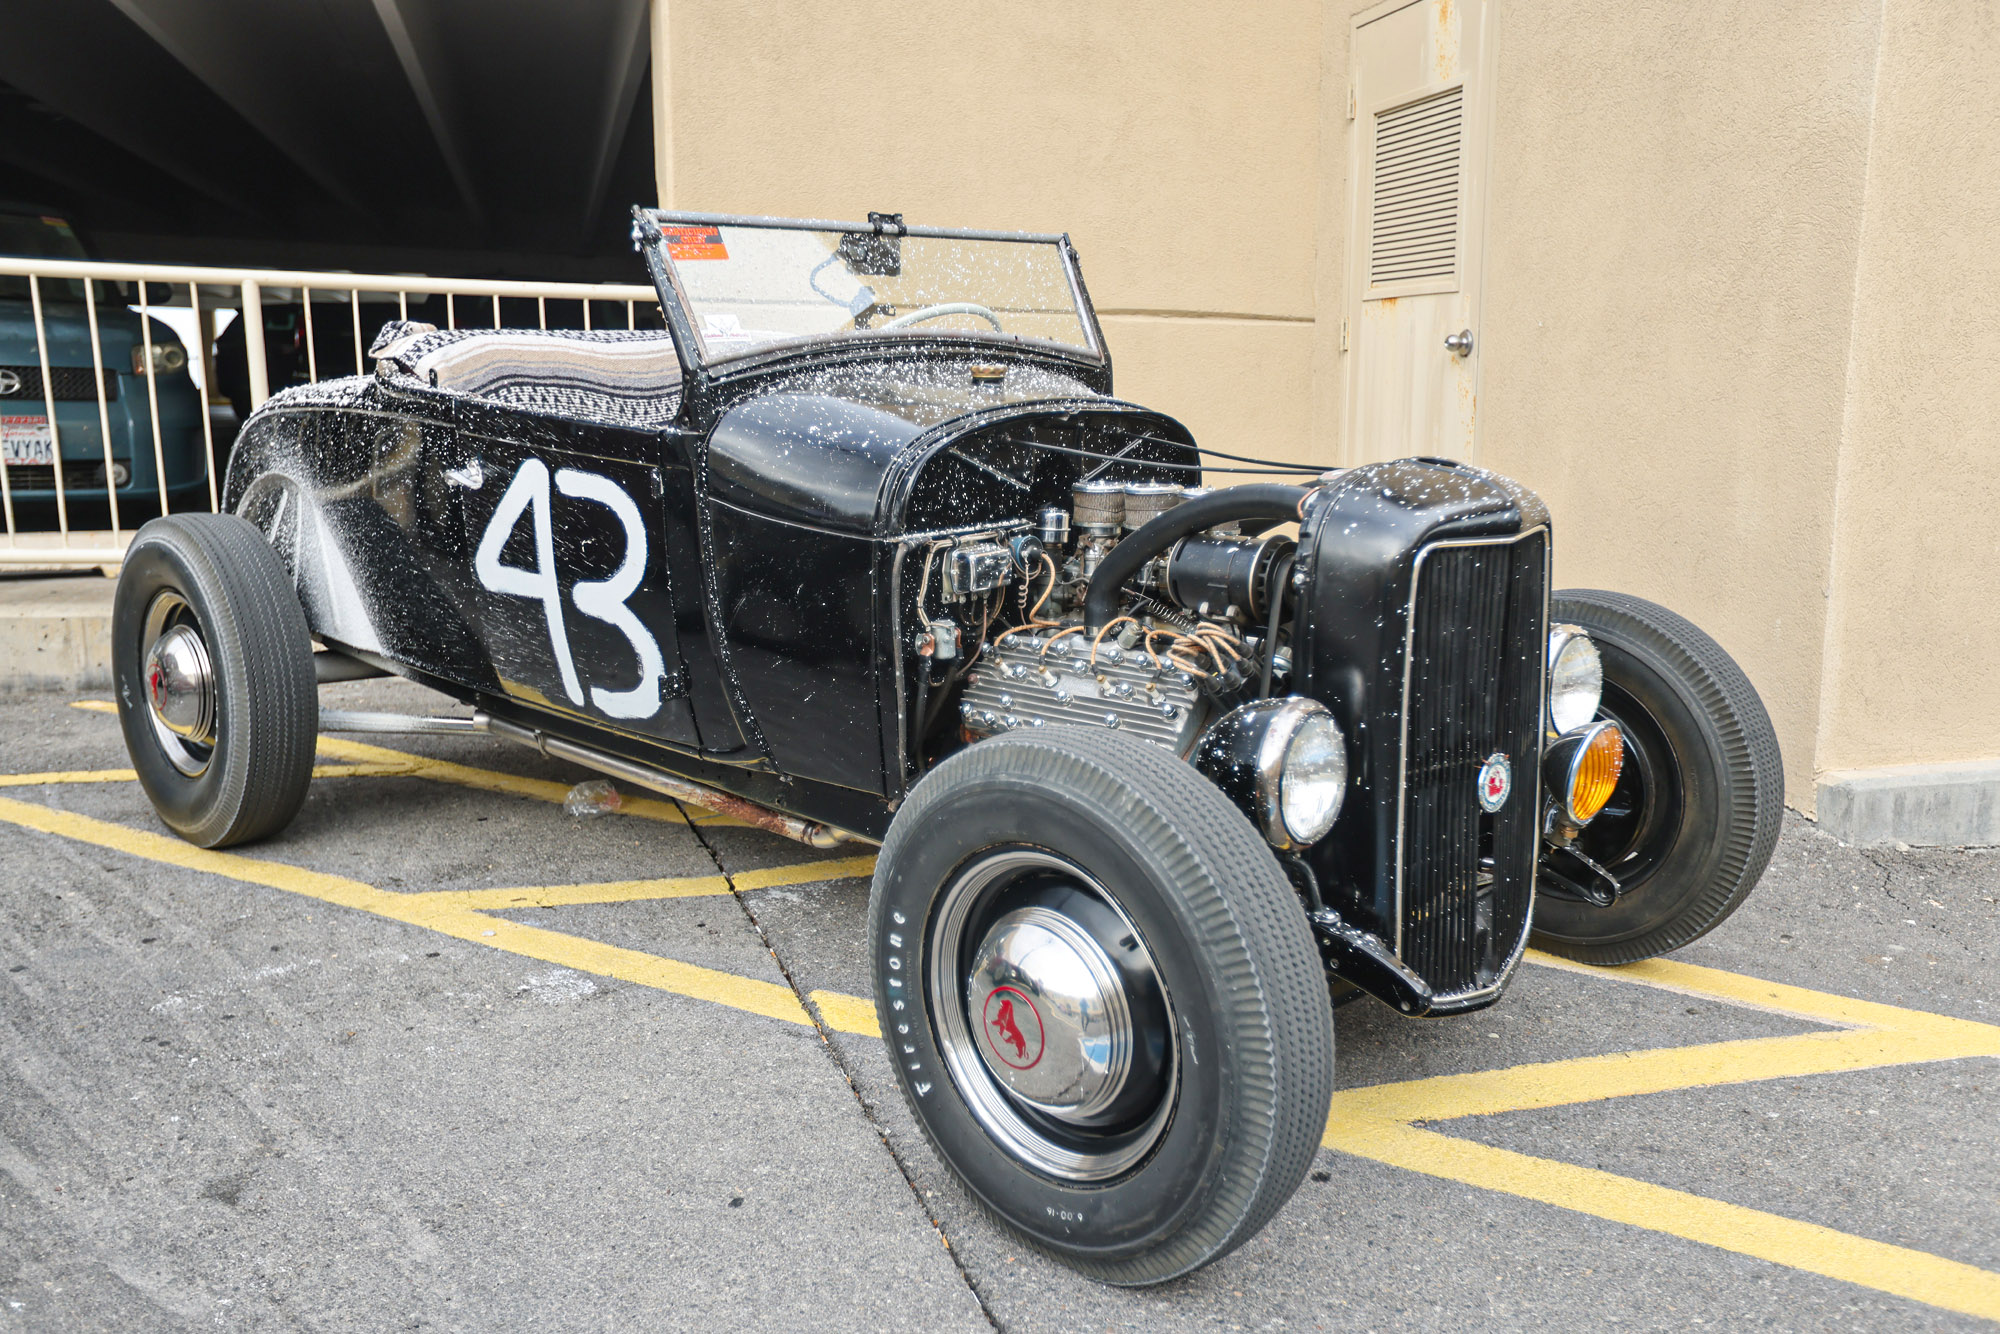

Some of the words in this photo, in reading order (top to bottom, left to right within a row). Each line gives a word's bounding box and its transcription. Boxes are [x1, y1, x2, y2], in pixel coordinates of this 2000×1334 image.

[661, 226, 719, 236] PARTICIPANT
[475, 457, 665, 719] 43
[888, 911, 932, 1097] Firestone
